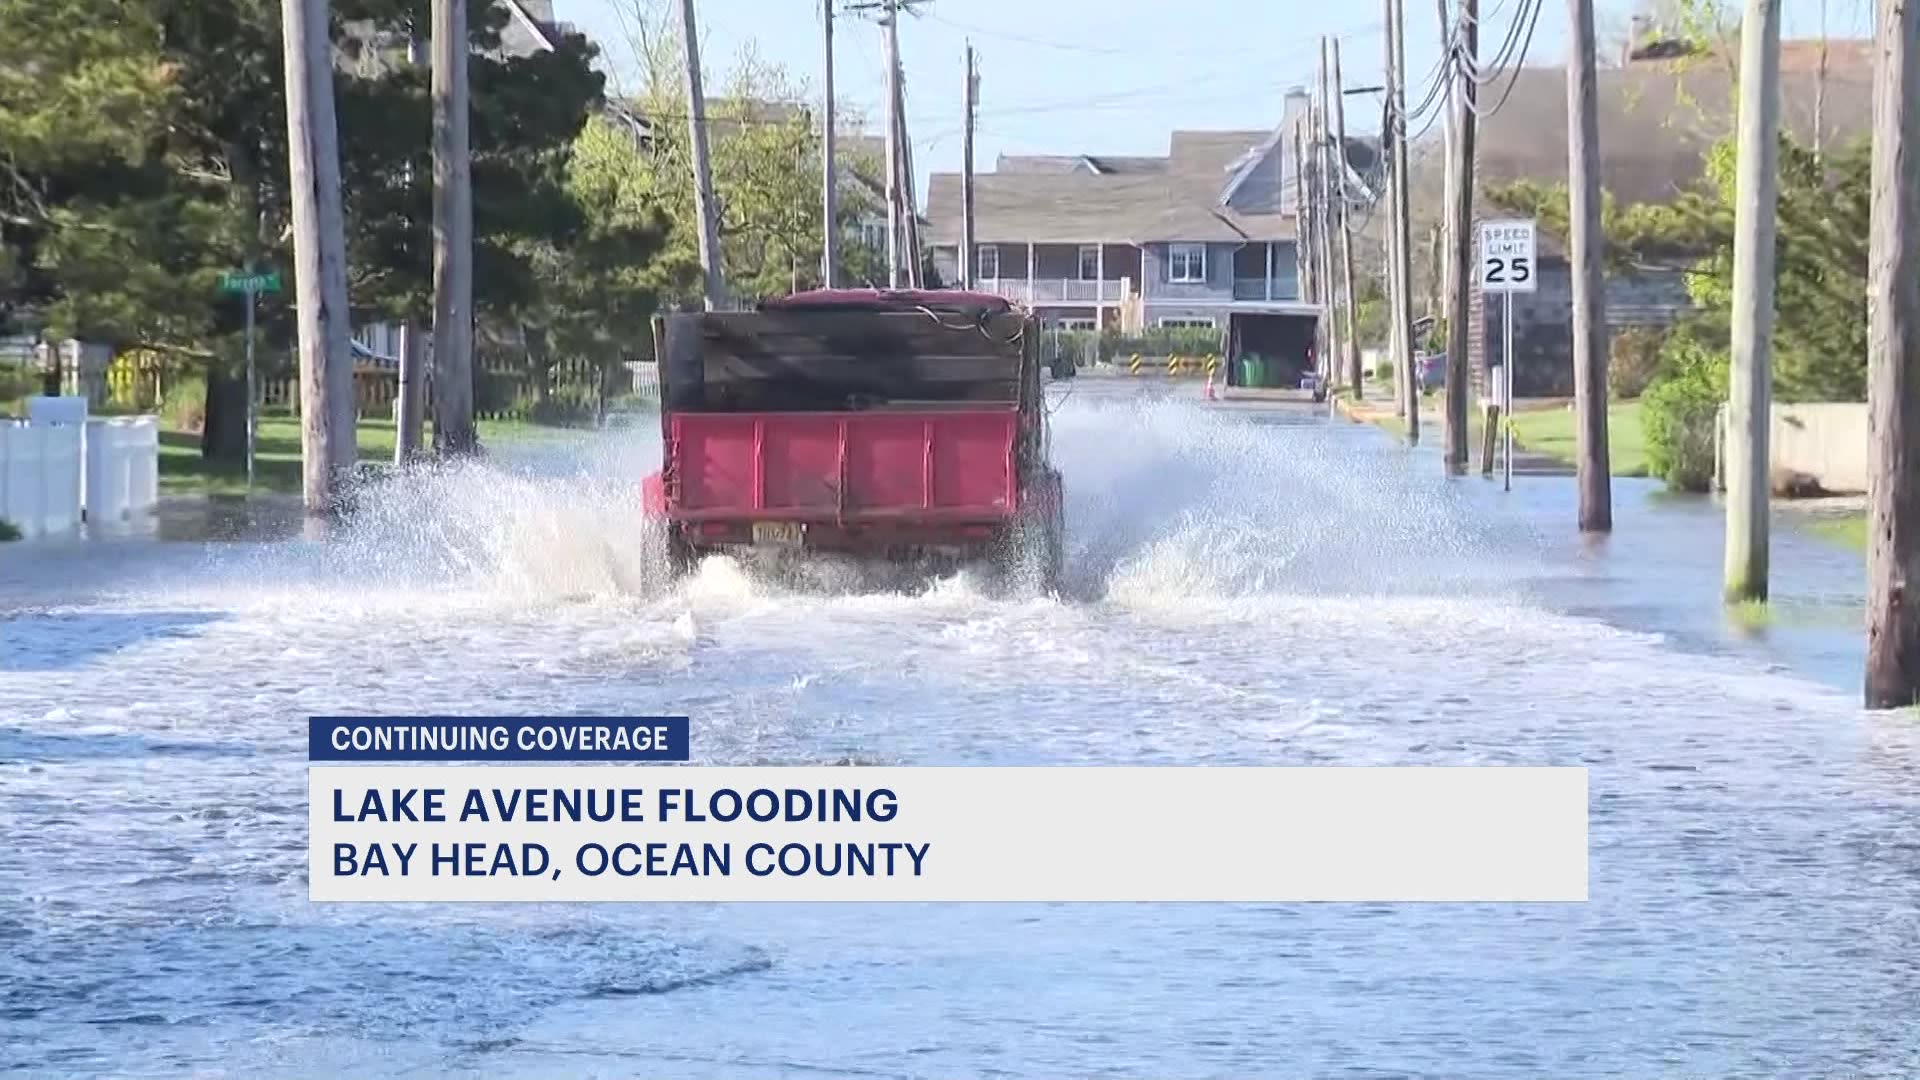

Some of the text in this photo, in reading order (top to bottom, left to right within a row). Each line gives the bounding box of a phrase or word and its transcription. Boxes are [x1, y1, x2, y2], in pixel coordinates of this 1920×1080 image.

[1485, 228, 1529, 240] SPEED
[1489, 243, 1525, 255] LIMIT
[1486, 258, 1529, 282] 25
